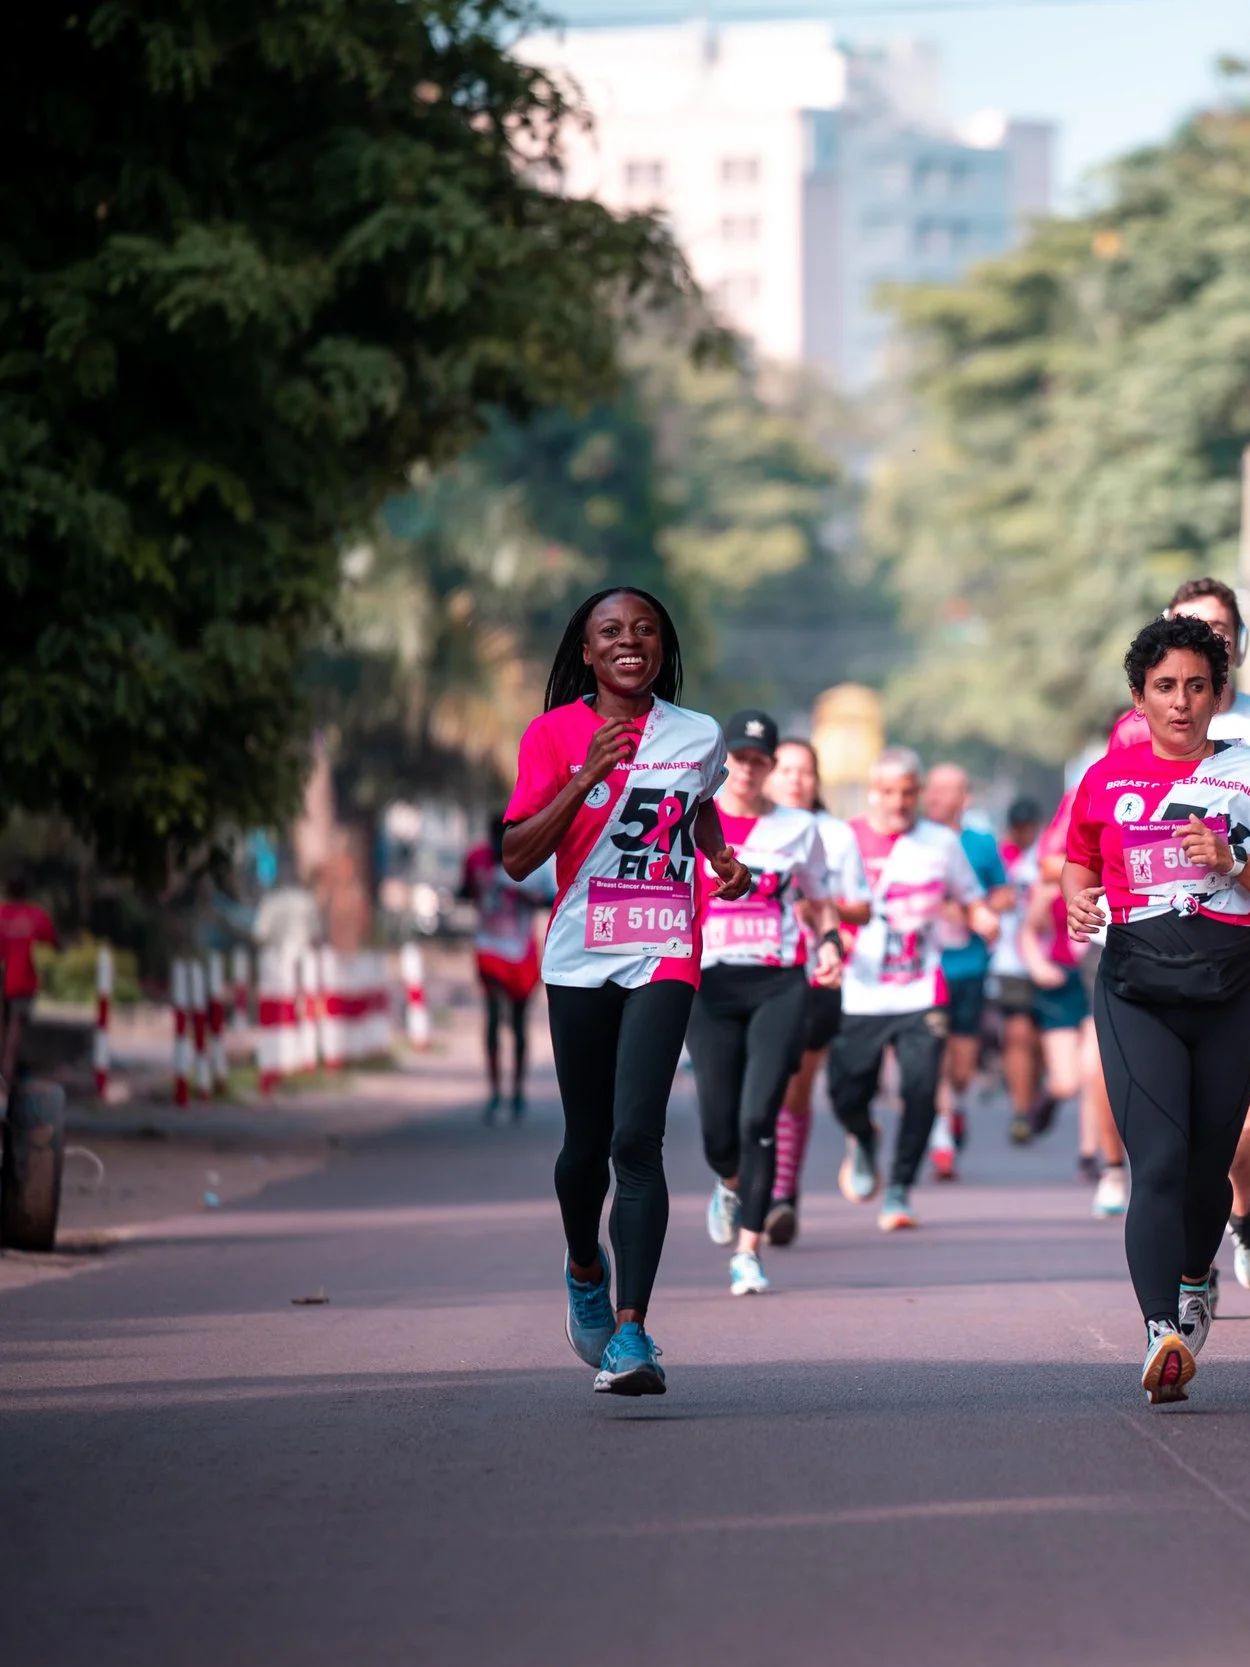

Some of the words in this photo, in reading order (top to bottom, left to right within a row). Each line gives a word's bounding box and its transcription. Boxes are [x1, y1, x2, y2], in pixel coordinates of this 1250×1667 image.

[613, 762, 650, 771] ANCER
[1106, 779, 1150, 790] BREAST
[1129, 849, 1153, 865] 5K
[596, 881, 617, 889] Breast
[617, 882, 640, 890] Cancer
[640, 883, 674, 891] Awareness
[592, 906, 618, 923] 5K
[628, 907, 687, 931] 5104
